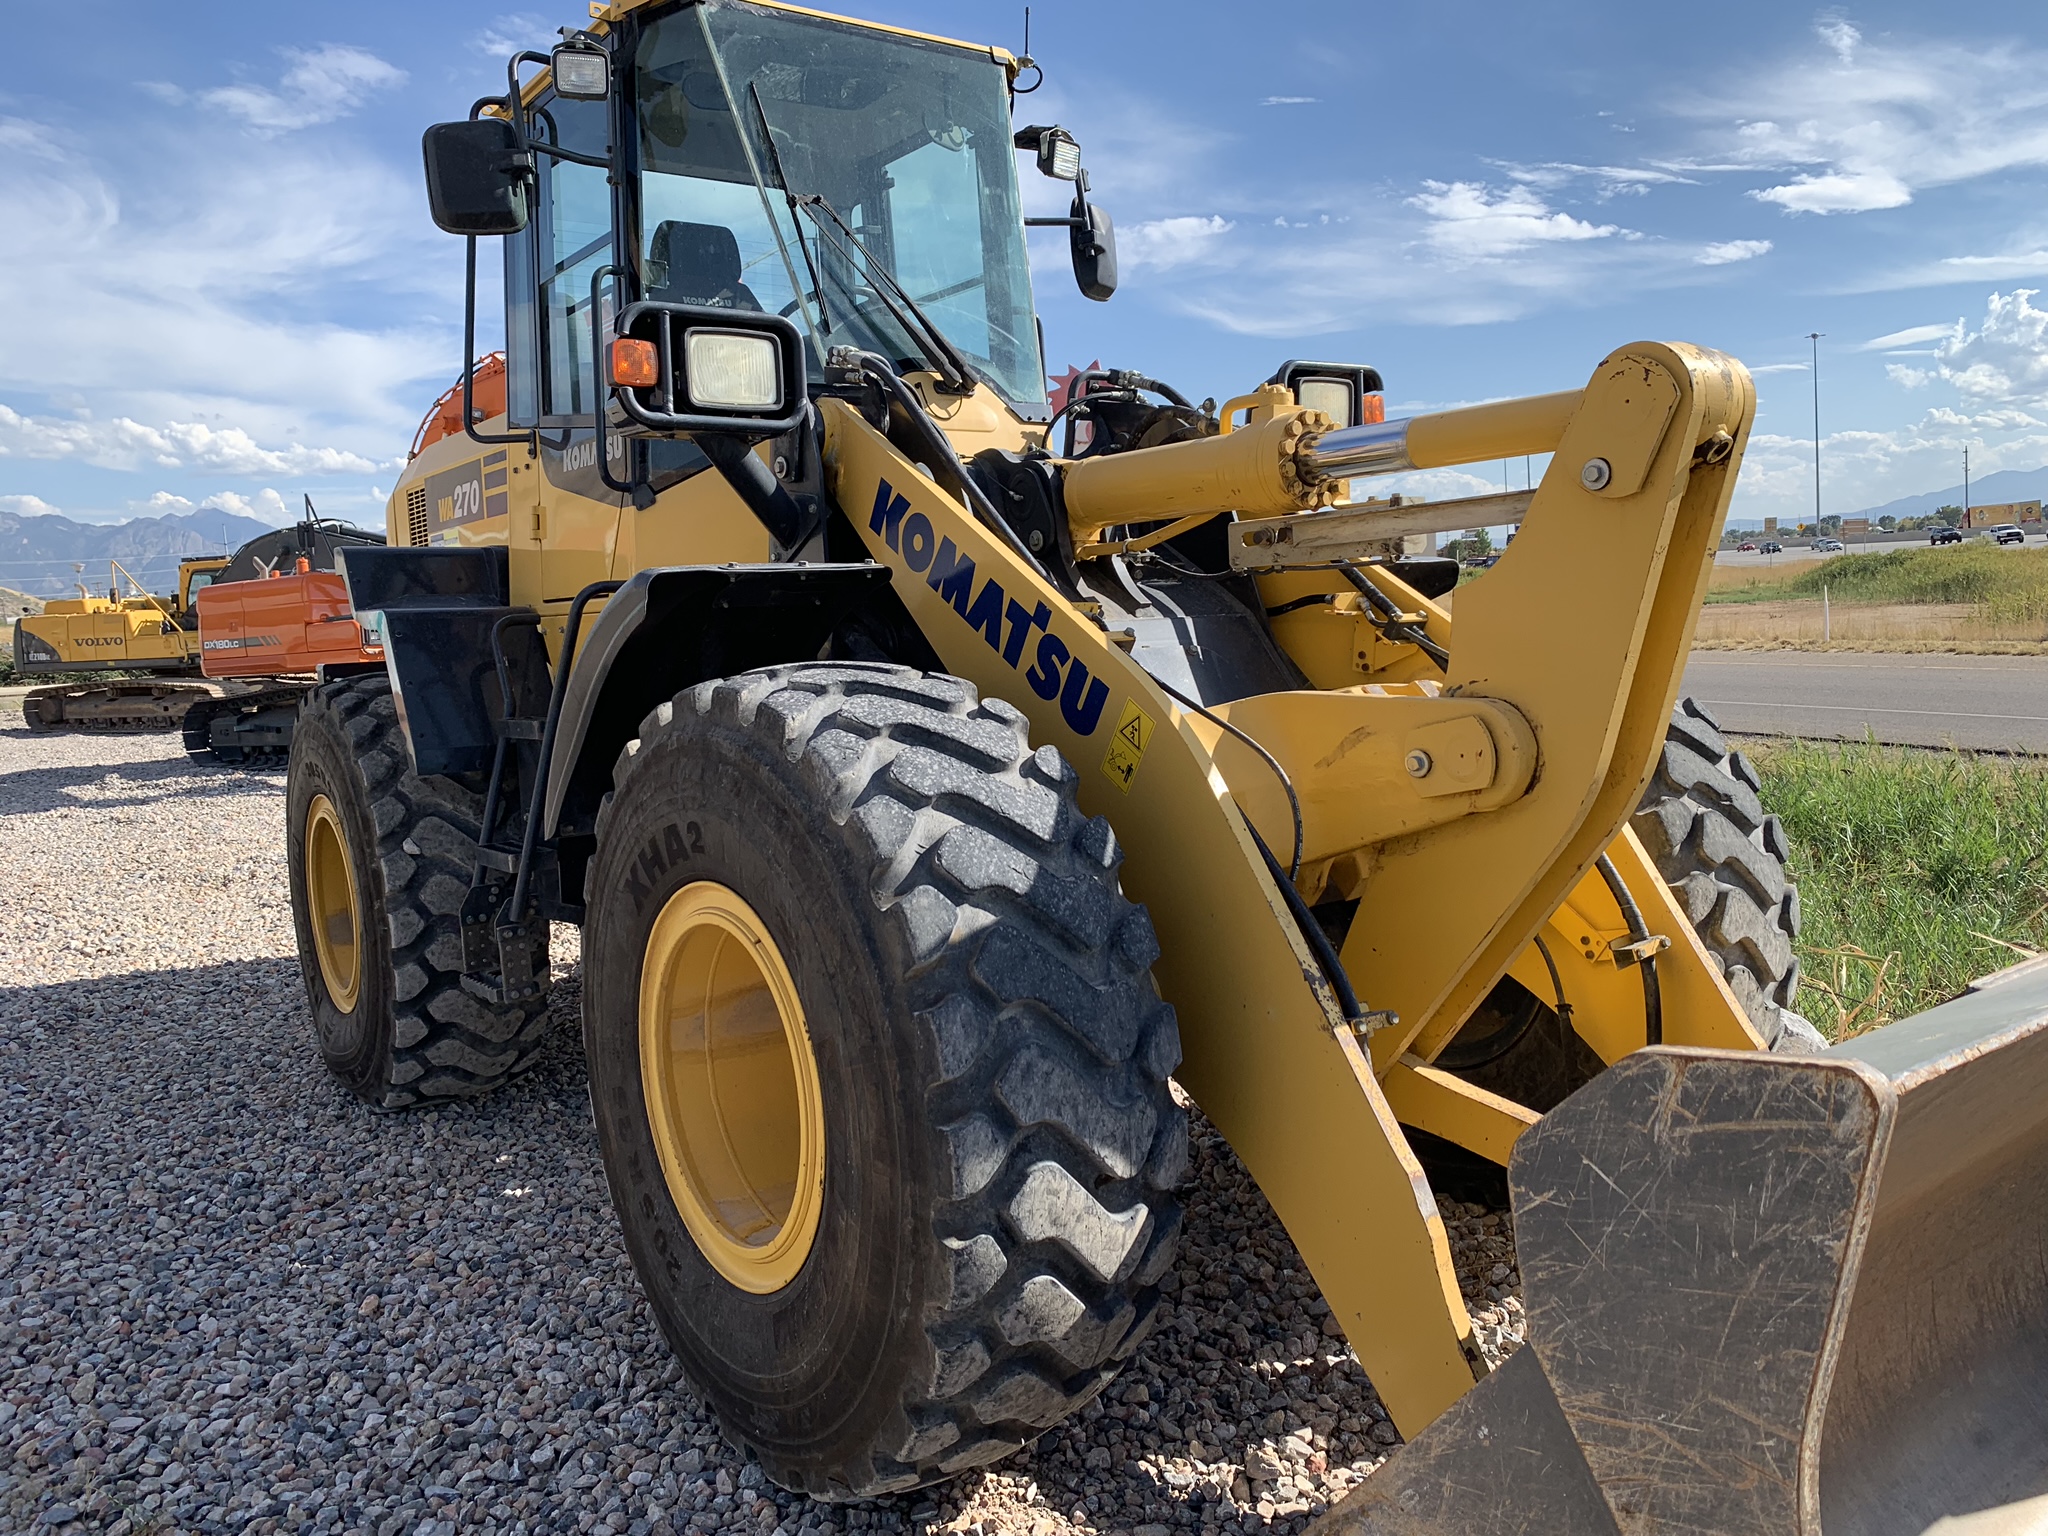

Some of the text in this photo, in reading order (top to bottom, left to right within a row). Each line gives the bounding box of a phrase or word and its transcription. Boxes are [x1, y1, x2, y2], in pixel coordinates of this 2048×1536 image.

[682, 296, 732, 307] KOMATSU
[563, 434, 623, 473] KOMASU
[437, 479, 480, 523] WA270
[868, 476, 1111, 737] KOMATSU
[73, 636, 124, 647] VOLVO
[622, 820, 706, 917] XHA2
